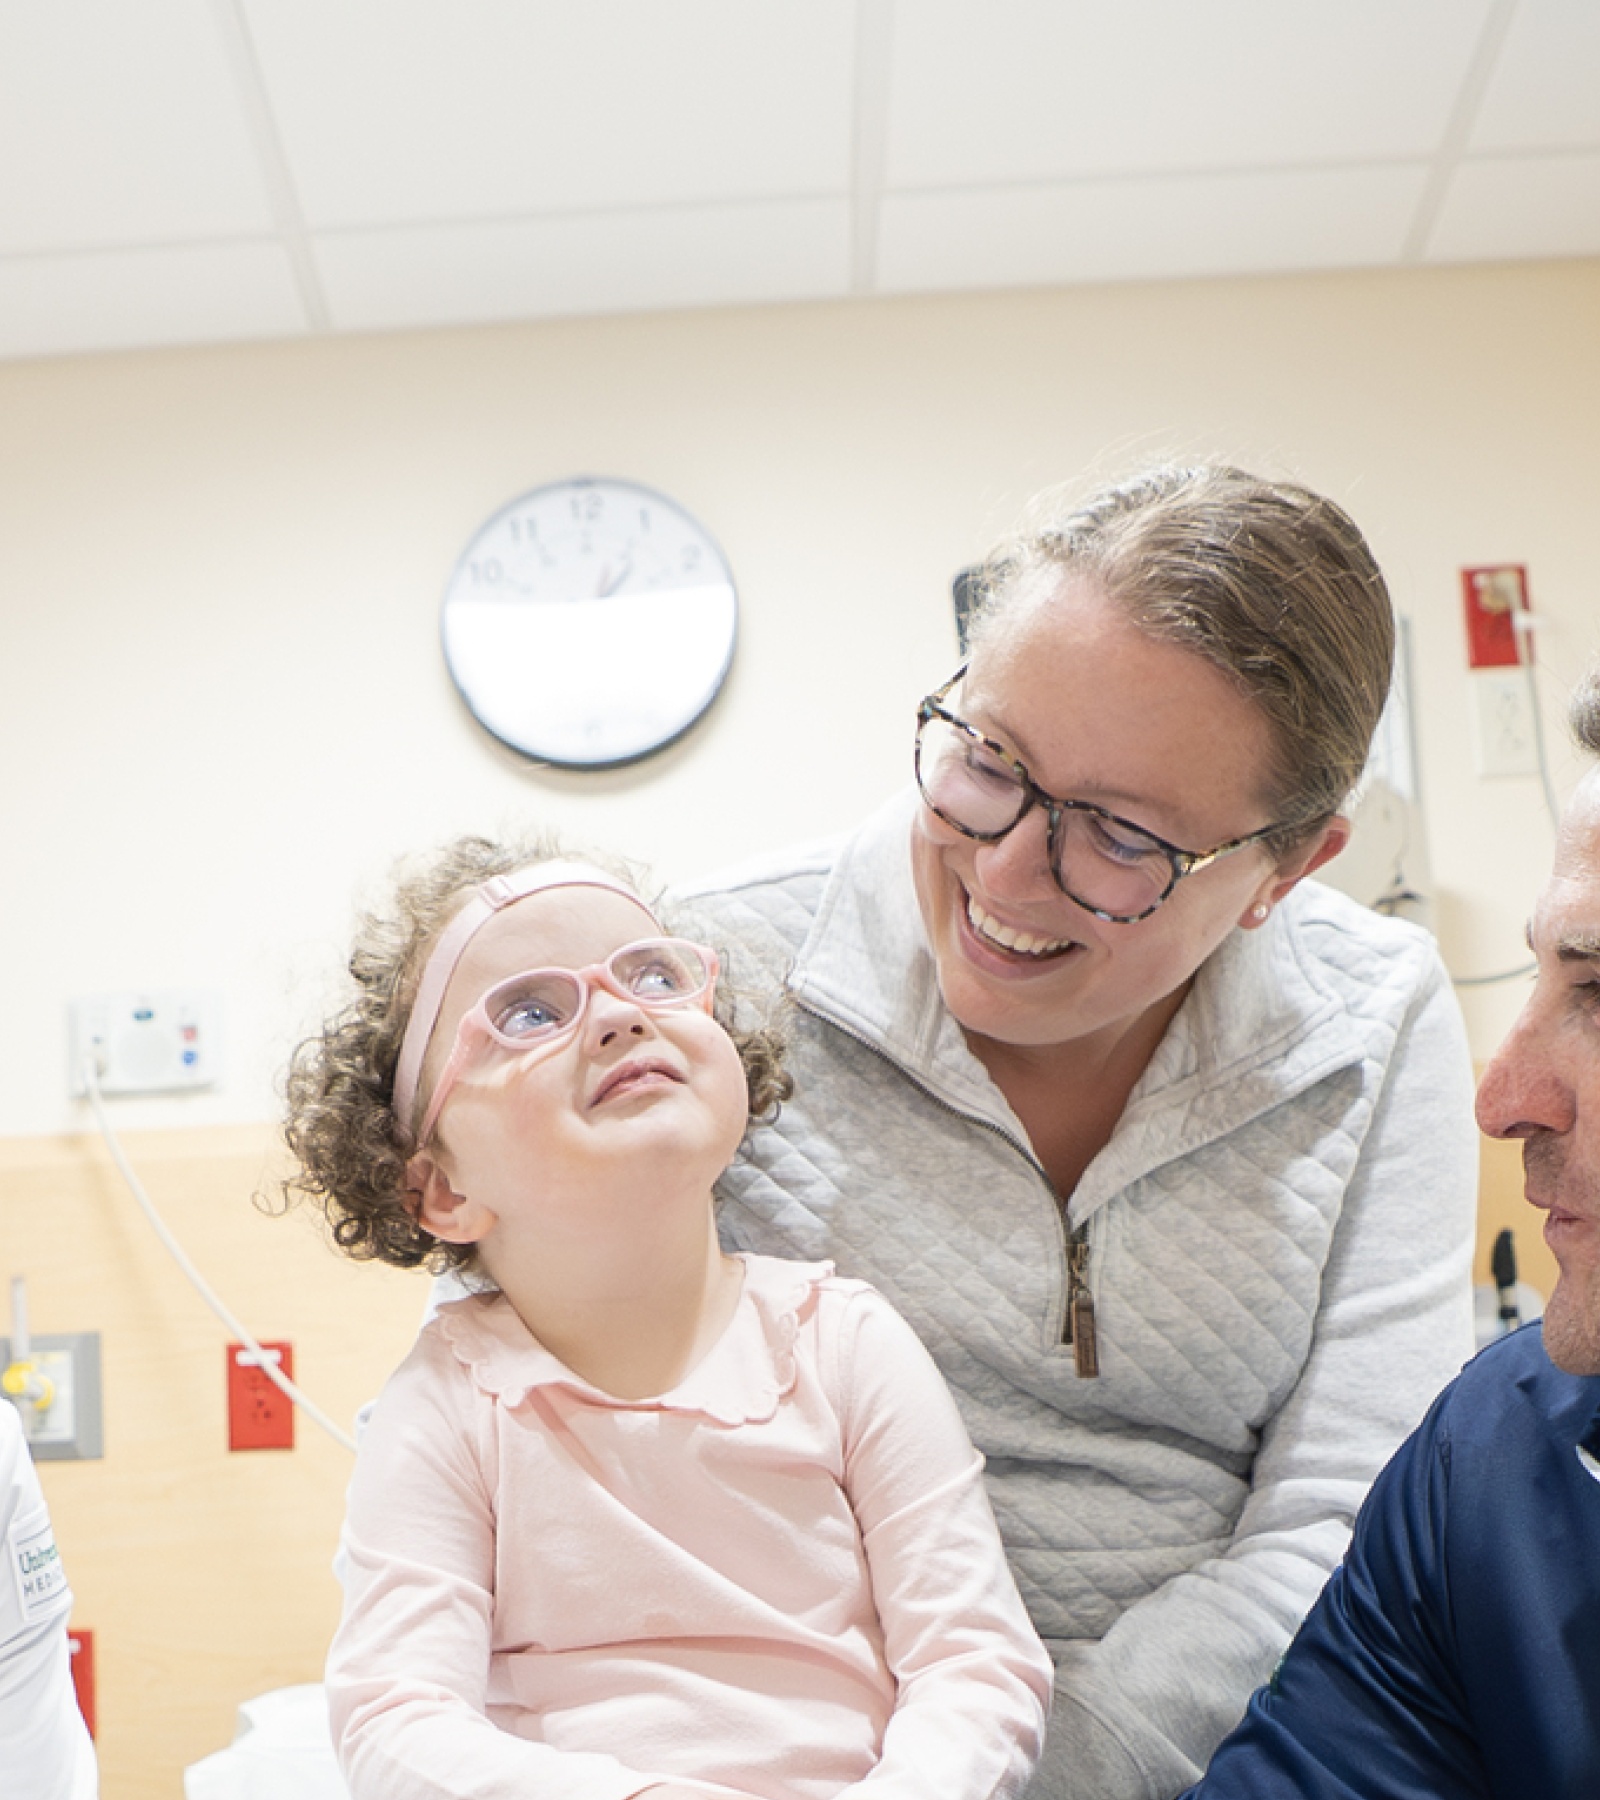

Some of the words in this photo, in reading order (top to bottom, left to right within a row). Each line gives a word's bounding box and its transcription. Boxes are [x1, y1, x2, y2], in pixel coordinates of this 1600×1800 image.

[570, 492, 604, 522] 12
[639, 508, 651, 532] 1
[511, 516, 538, 543] 11
[469, 557, 504, 584] 10
[680, 544, 701, 573] 2
